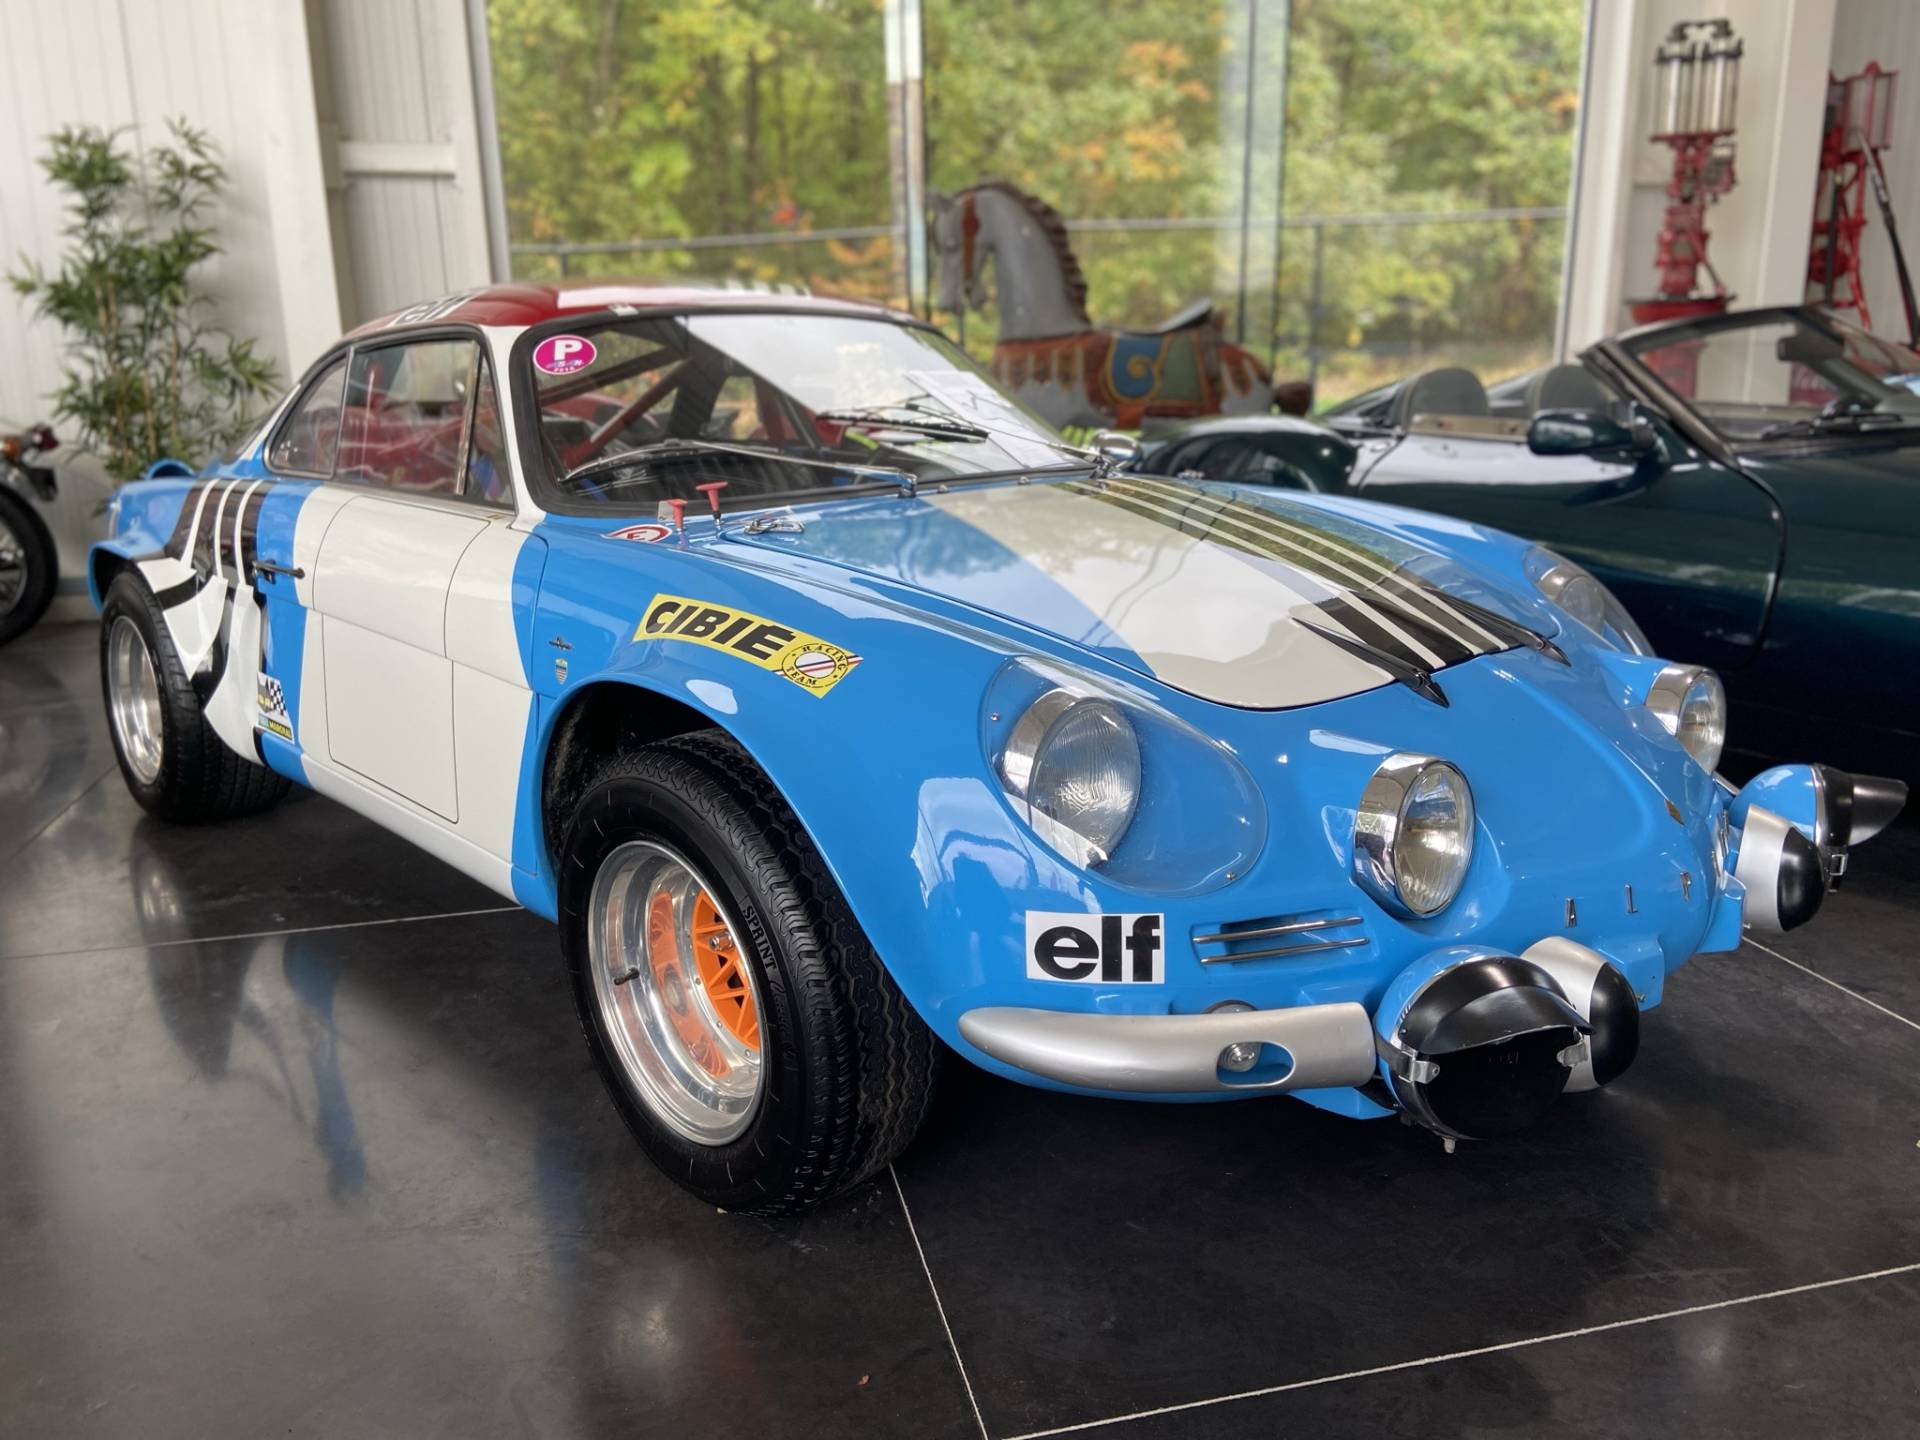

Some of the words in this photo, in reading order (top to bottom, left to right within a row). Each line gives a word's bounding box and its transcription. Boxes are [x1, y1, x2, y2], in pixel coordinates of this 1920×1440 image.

[554, 339, 583, 361] P
[802, 645, 847, 670] RACING
[786, 666, 818, 686] TEAM
[742, 905, 777, 971] SPRINT
[1033, 914, 1161, 983] elf
